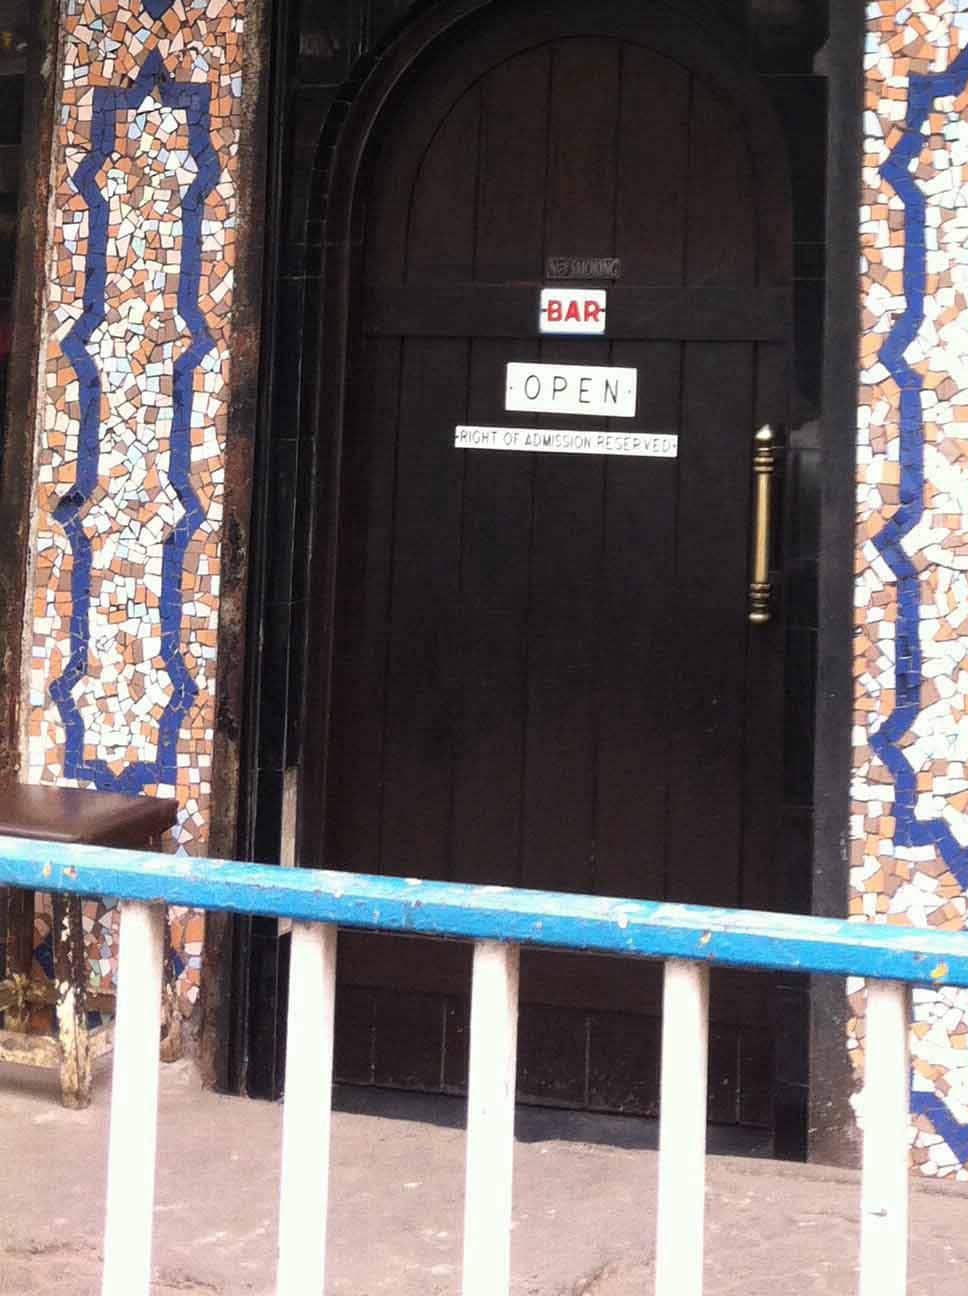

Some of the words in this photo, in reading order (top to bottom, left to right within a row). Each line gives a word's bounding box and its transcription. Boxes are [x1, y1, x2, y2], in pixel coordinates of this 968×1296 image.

[547, 300, 601, 322] BAR
[524, 374, 619, 404] OPEN
[460, 430, 497, 445] RIGHT
[503, 432, 521, 446] OF
[524, 434, 591, 449] ADMISSION
[597, 435, 672, 453] RESERVED
